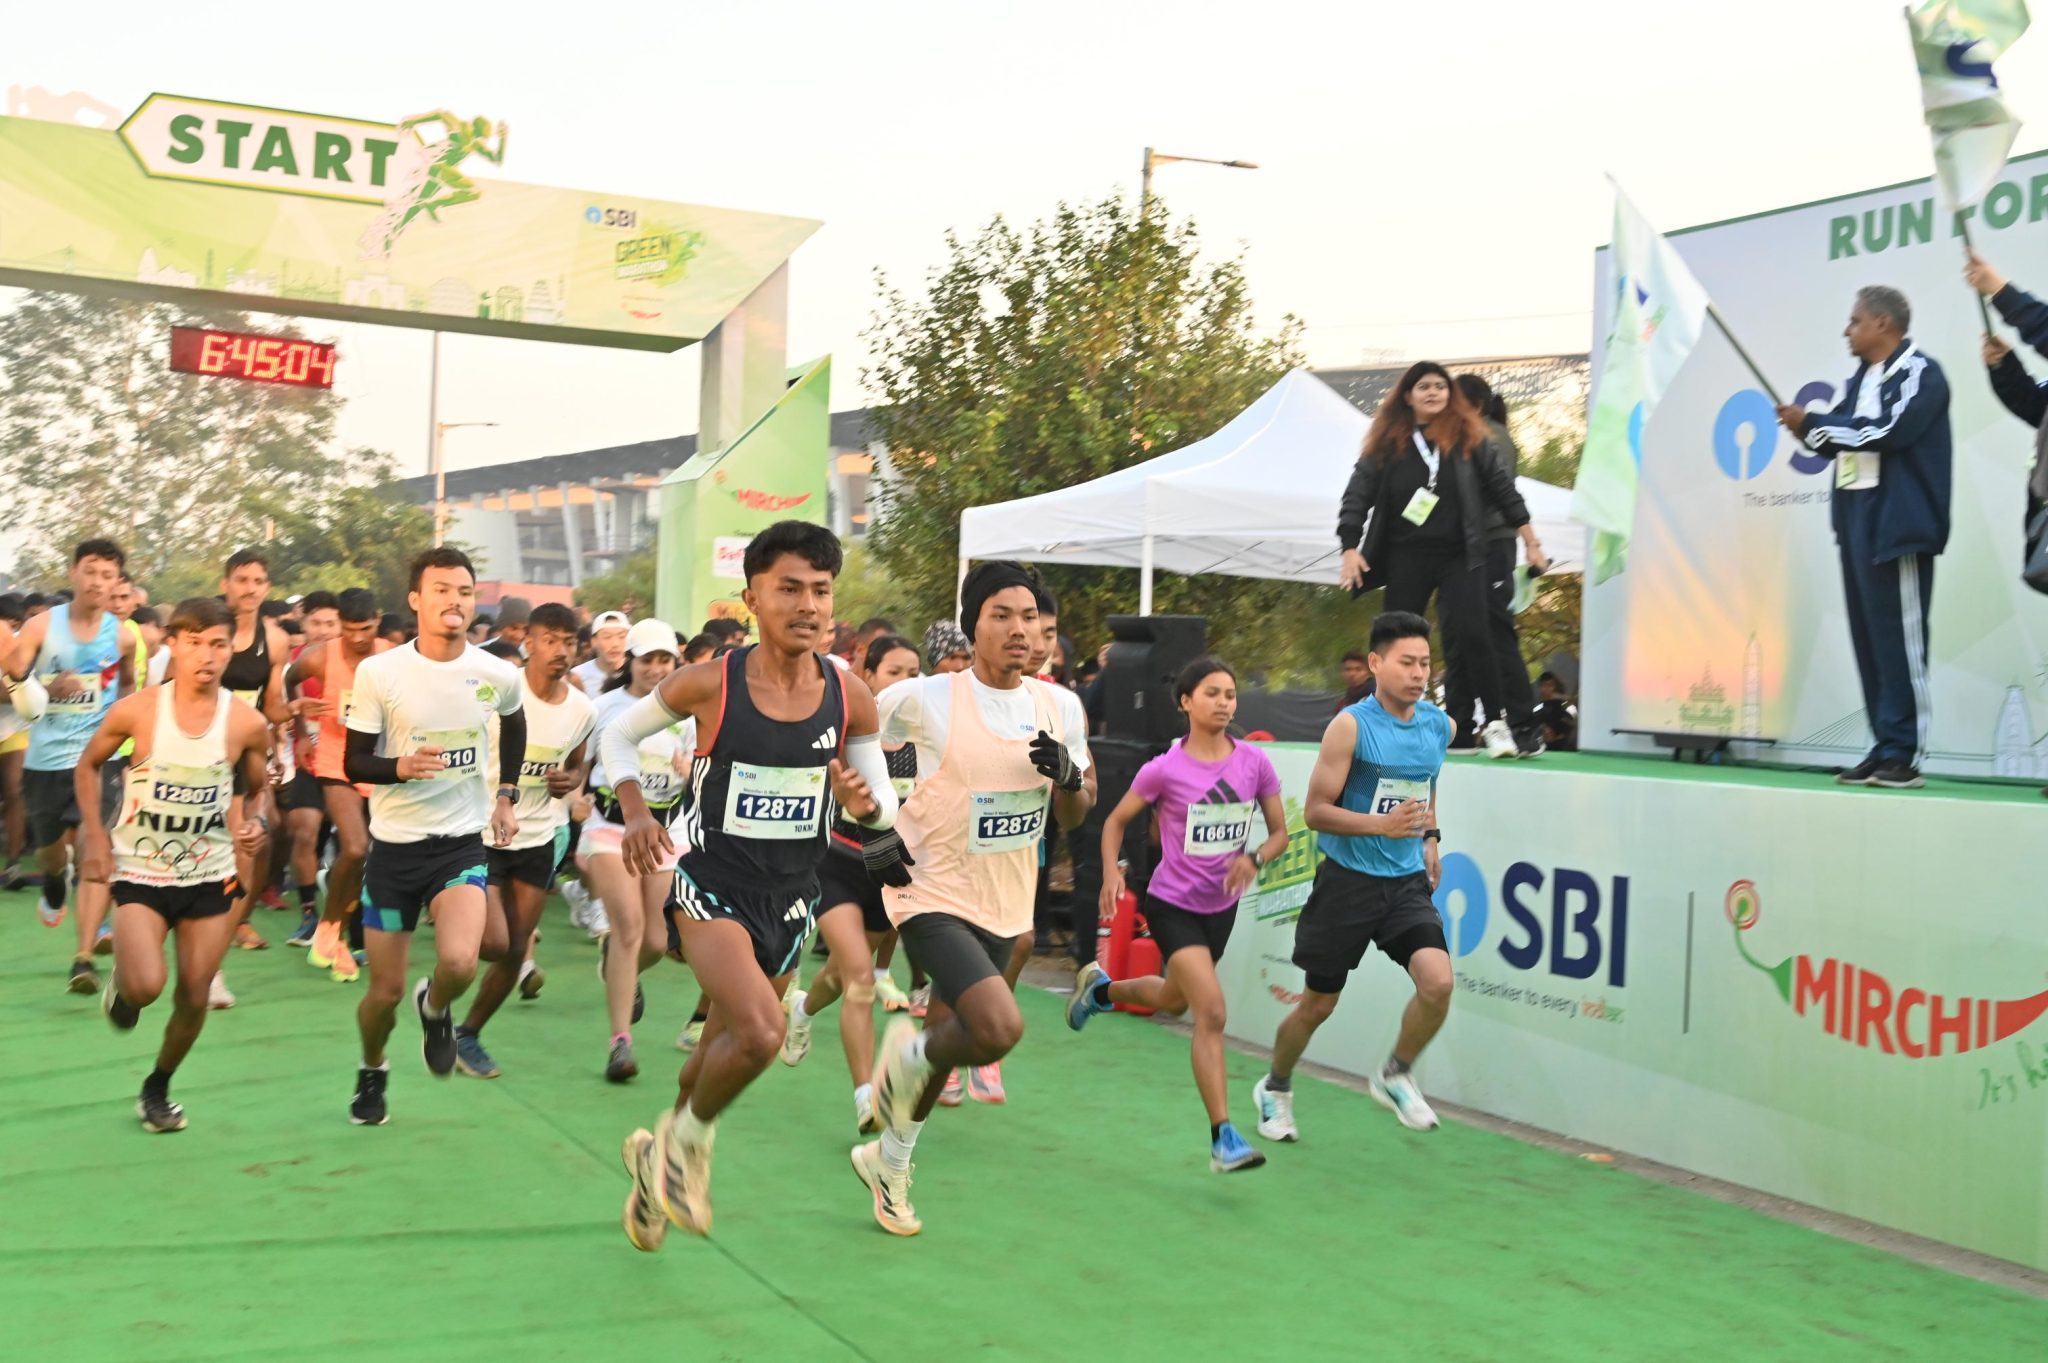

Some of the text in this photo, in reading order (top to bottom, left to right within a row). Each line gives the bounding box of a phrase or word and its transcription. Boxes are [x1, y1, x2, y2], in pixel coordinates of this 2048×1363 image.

[168, 114, 398, 187] START
[604, 208, 637, 228] SBI
[1828, 198, 1934, 261] RUN
[616, 235, 672, 263] GREEN
[199, 335, 336, 384] 6:45:04
[737, 489, 797, 512] MIRCHI
[1743, 490, 1767, 508] The
[1769, 489, 1813, 507] banker
[744, 772, 757, 780] SBI
[157, 784, 216, 804] 12807
[742, 796, 811, 819] 12871
[983, 810, 1042, 836] 12873
[1497, 861, 1631, 988] SBI
[1455, 971, 1476, 992] The
[1479, 977, 1522, 1001] banker
[1525, 988, 1538, 1006] to
[1541, 994, 1579, 1019] every
[1794, 954, 1991, 1059] MIRCHI
